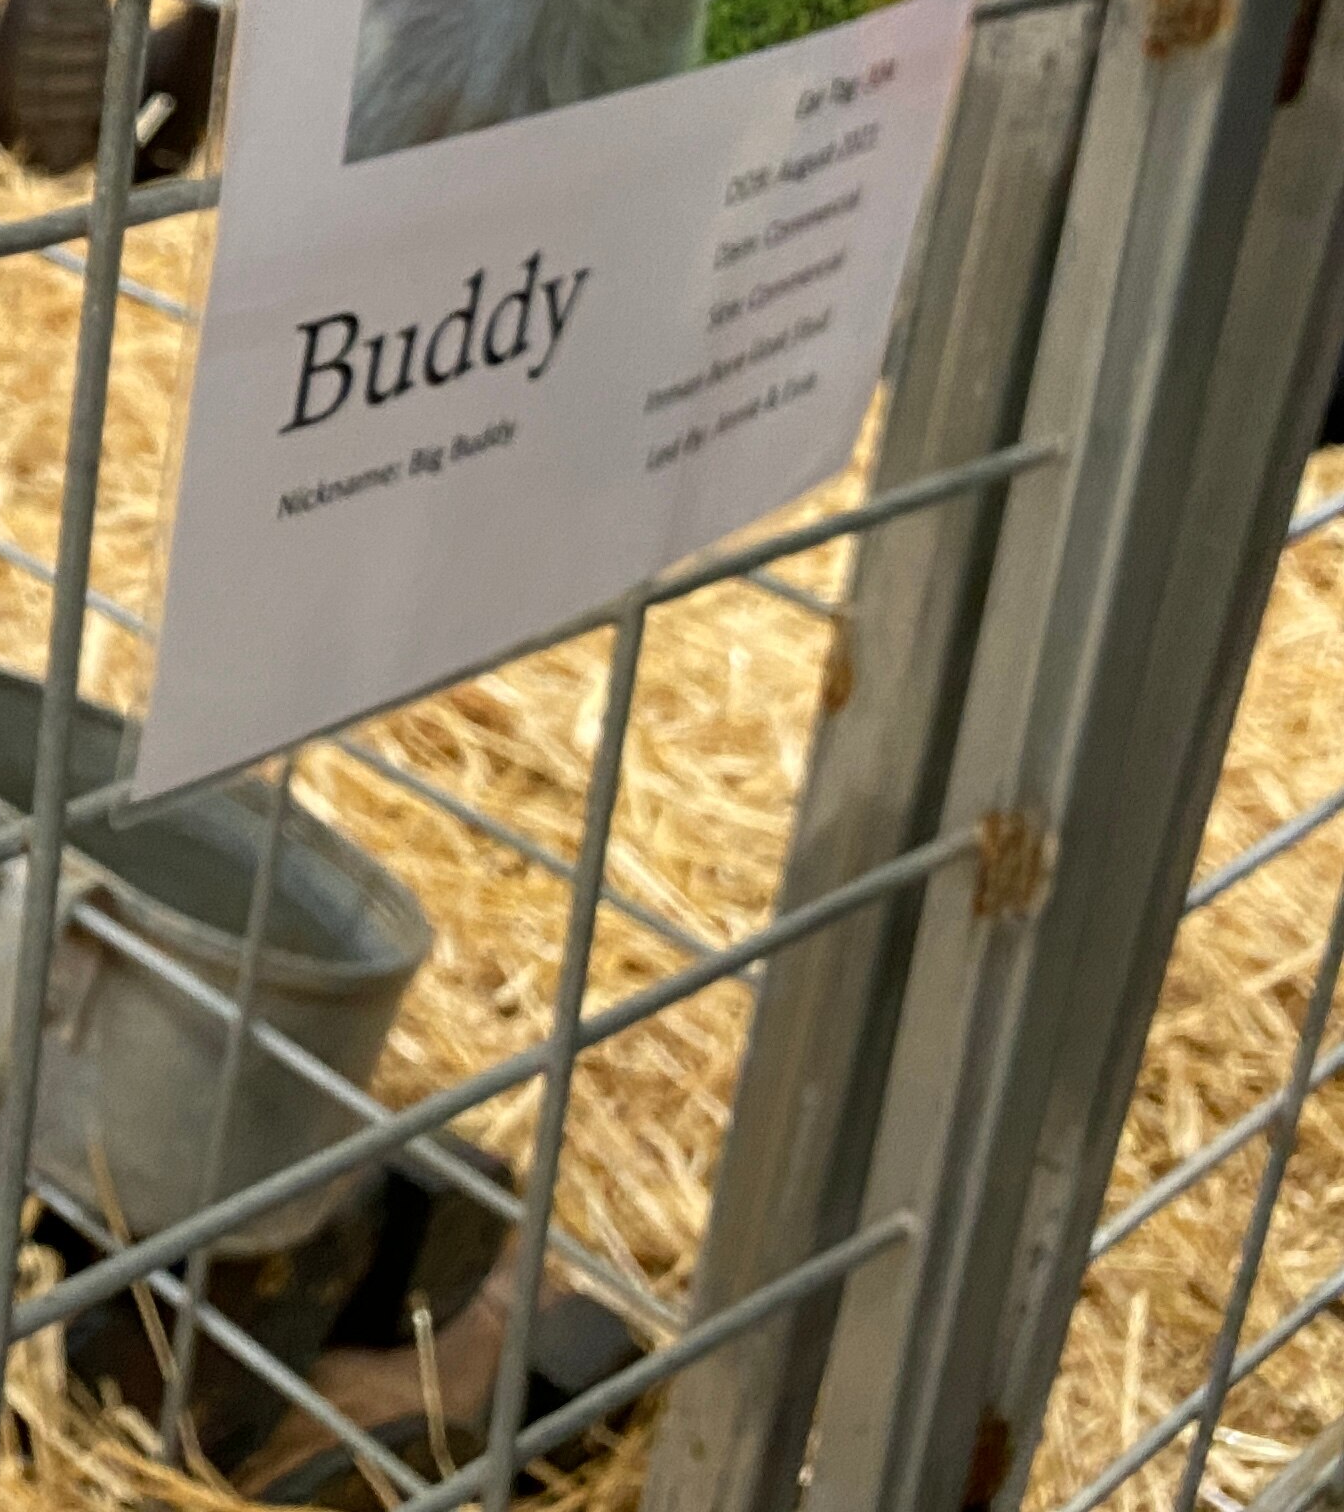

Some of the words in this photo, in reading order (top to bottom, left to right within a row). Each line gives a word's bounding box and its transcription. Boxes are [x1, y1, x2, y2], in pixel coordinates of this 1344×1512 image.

[280, 252, 589, 438] Buddy
[276, 462, 402, 520] Nickname:
[409, 445, 445, 477] Big
